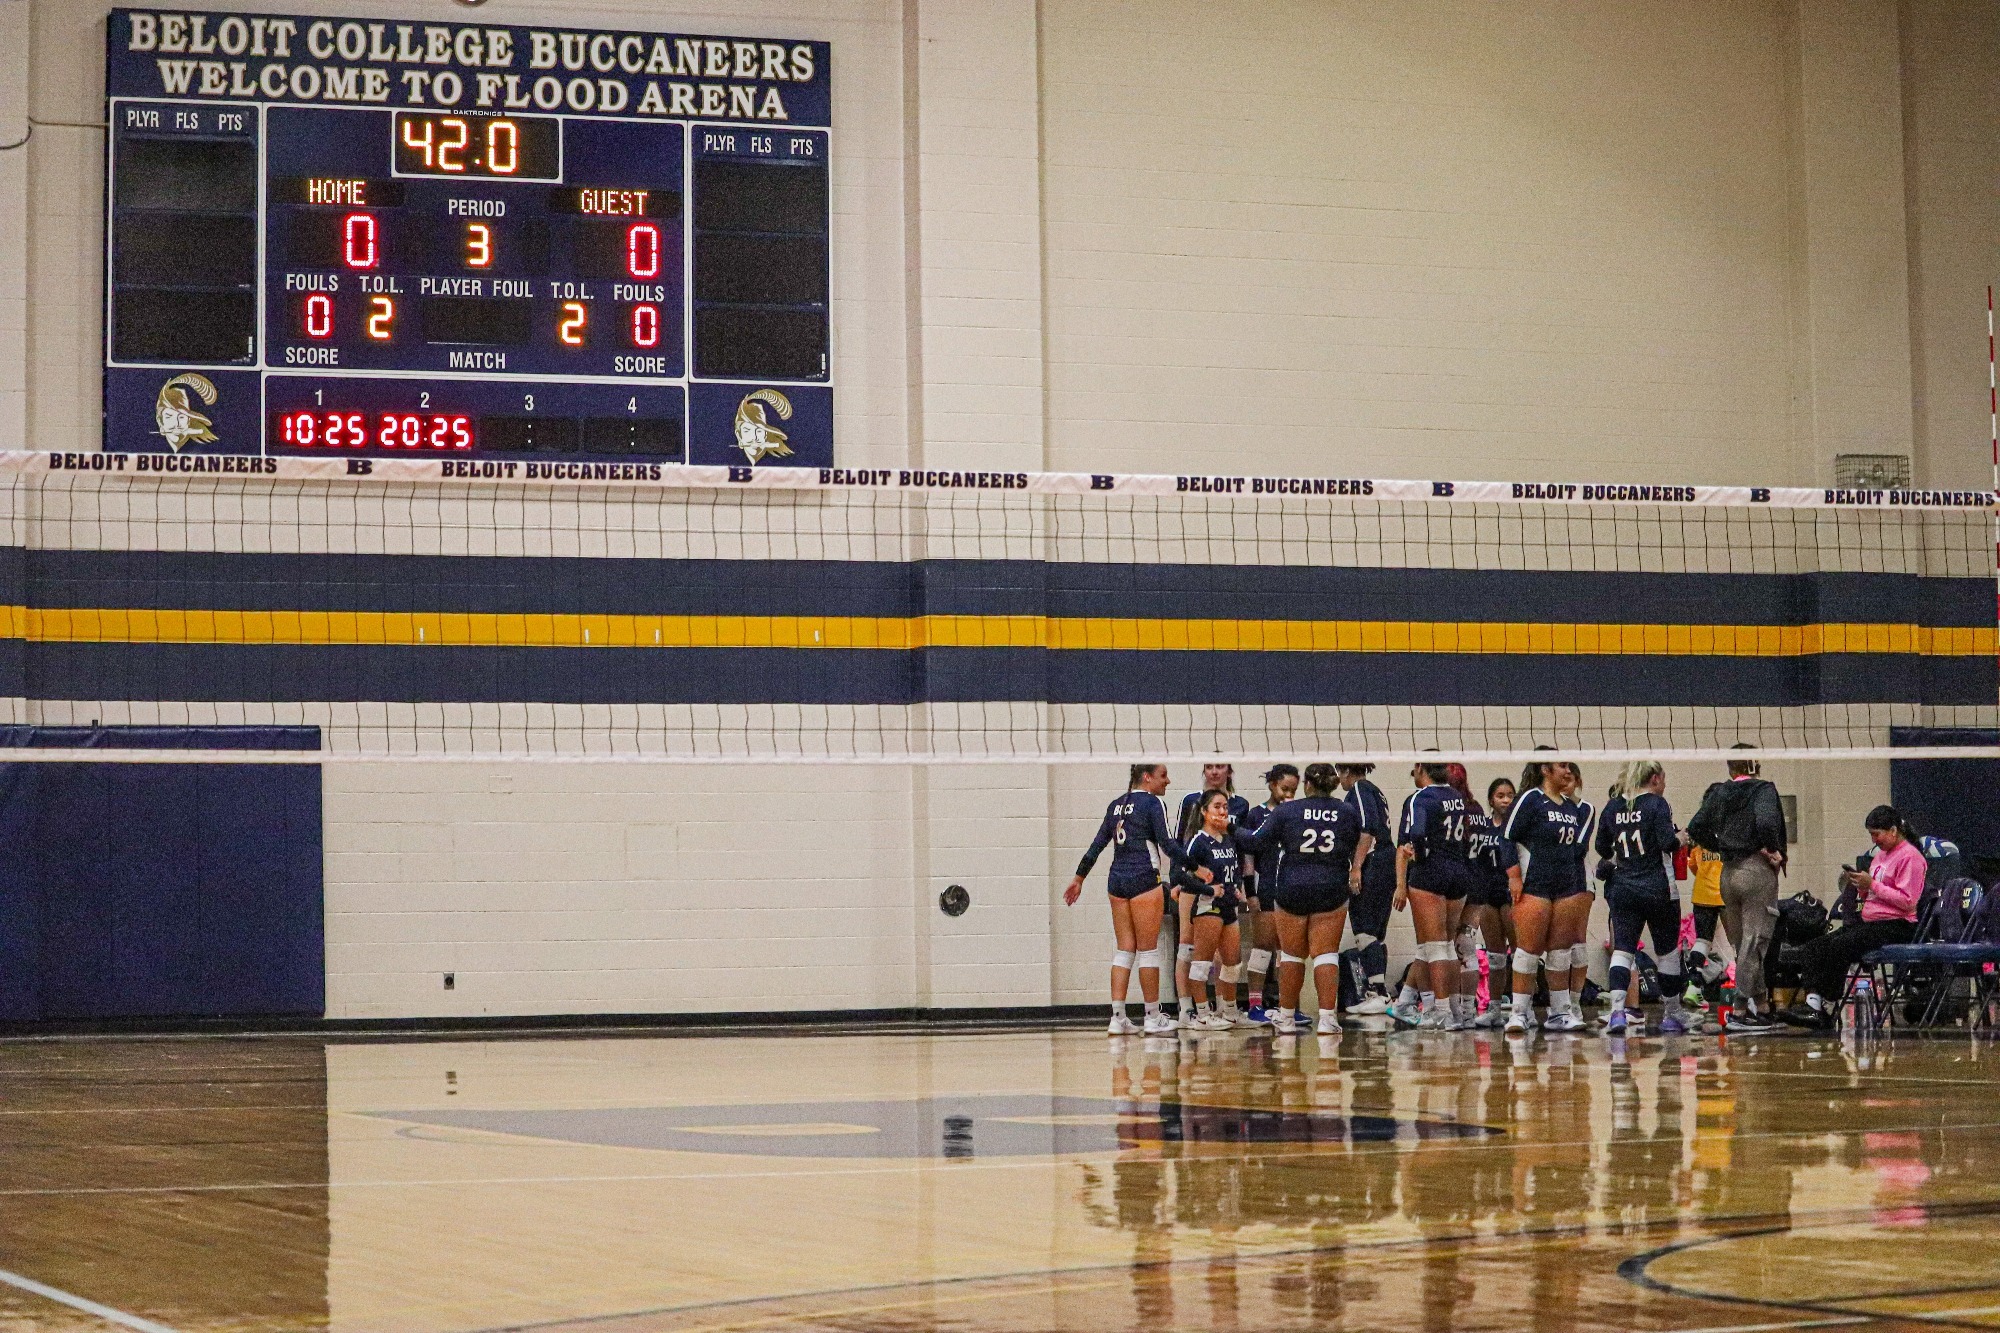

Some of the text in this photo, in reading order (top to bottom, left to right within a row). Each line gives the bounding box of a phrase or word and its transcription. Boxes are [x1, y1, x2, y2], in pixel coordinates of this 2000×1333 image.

[129, 13, 815, 82] BELOIT COLLEGE BUCCANEERS
[157, 59, 788, 120] WELCOME TO FLOOD ARENA
[127, 111, 243, 131] PLYR FLS PTS
[453, 109, 502, 117] DAKTRONICS
[403, 119, 518, 173] 42.0
[704, 134, 813, 156] PLYR FLS PTS
[309, 179, 366, 205] HOME
[448, 199, 506, 217] PERIOD
[581, 189, 648, 216] GUEST
[345, 215, 375, 267] 0
[468, 225, 490, 266] 3
[629, 225, 657, 276] 0
[286, 273, 339, 291] FOULS
[360, 276, 404, 294] T.O.L.
[421, 278, 533, 298] PLAYER FOUL
[551, 282, 594, 300] T.O.L.
[614, 285, 665, 302] FOULS
[306, 296, 330, 337] 0
[369, 297, 393, 339] 2
[561, 303, 585, 344] 2
[634, 306, 657, 346] 0
[285, 347, 338, 365] SCORE
[449, 352, 506, 370] MATCH
[614, 356, 666, 374] SCORE
[315, 389, 323, 406] 1
[420, 392, 430, 409] 2
[525, 395, 534, 411] 3
[627, 397, 637, 413] 4
[284, 414, 365, 445] 10:25
[380, 417, 470, 447] 20:25
[49, 453, 277, 473] BELOIT BUCCANEERS
[346, 459, 373, 475] B
[441, 461, 662, 481] BELOIT BUCCANEERS
[728, 466, 753, 482] B
[819, 469, 1028, 489] BELOIT BUCCANEERS
[1090, 475, 1114, 490] B
[1176, 476, 1374, 495] BELOIT BUCCANEERS
[1432, 482, 1454, 496] B
[1512, 483, 1696, 502] BELOIT BUCCANEERS
[1750, 488, 1771, 502] B
[1824, 490, 1995, 506] BELOIT BUCCANEERS
[1442, 798, 1465, 811] BUCS
[1303, 808, 1338, 822] BUCS
[1615, 811, 1642, 824] BUCS
[1116, 819, 1127, 845] 6
[1443, 815, 1464, 841] 16
[1558, 826, 1575, 845] 18
[1300, 828, 1336, 853] 23
[1617, 829, 1645, 858] 11
